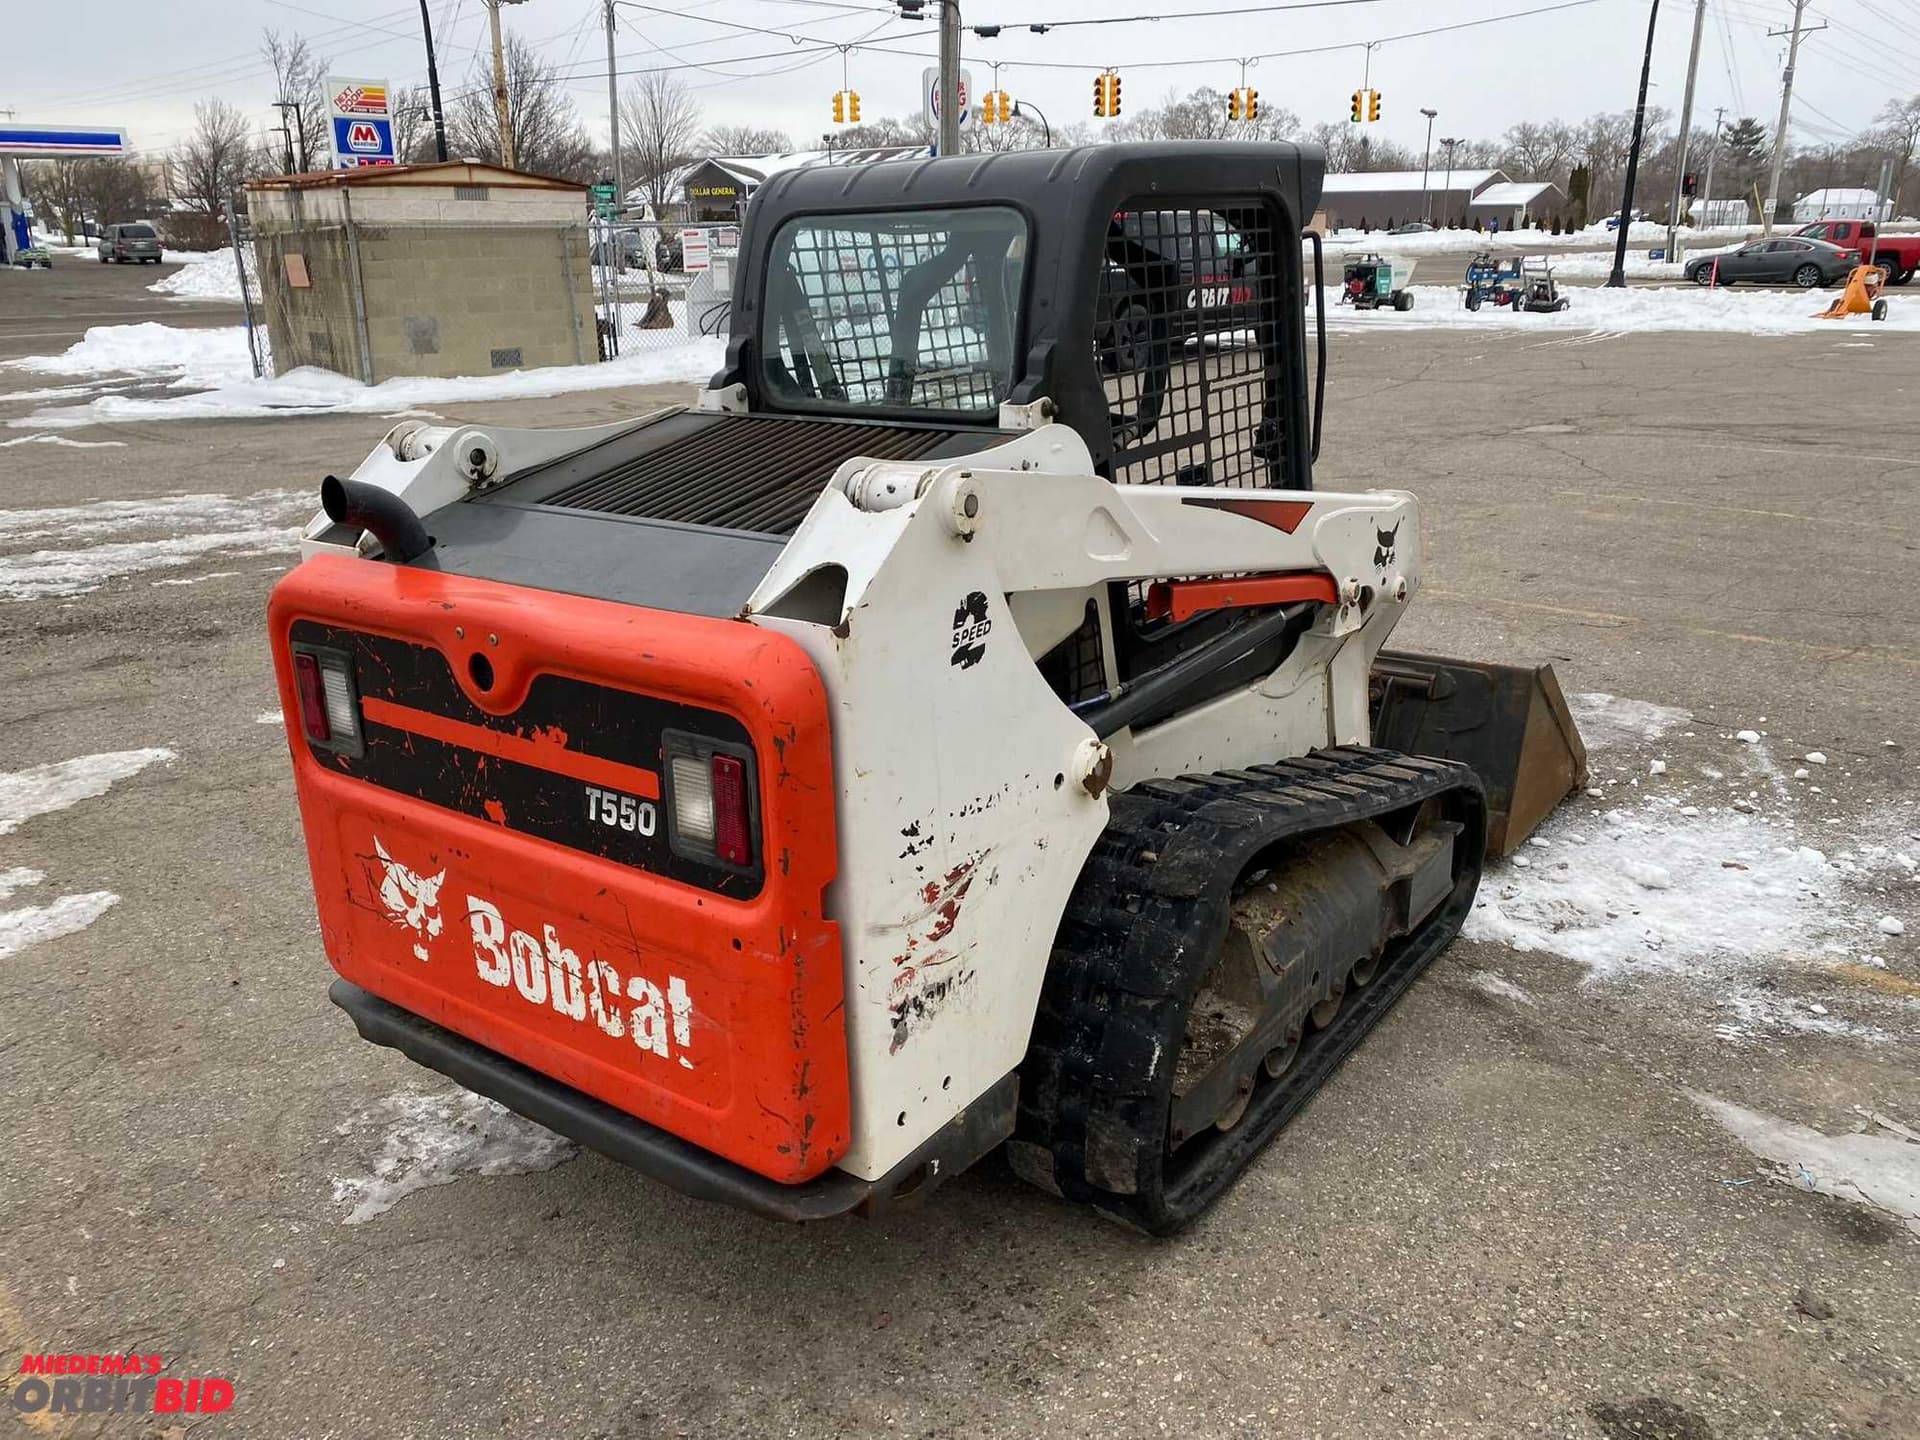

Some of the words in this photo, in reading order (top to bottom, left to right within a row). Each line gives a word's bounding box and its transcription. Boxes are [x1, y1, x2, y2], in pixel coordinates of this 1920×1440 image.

[333, 86, 353, 107] NEXT
[340, 88, 363, 112] DOOR
[690, 187, 711, 196] DOLLAR
[711, 186, 736, 195] GENERAL
[952, 620, 992, 648] SPEED
[585, 786, 657, 837] T550
[466, 894, 694, 1070] Bobcat
